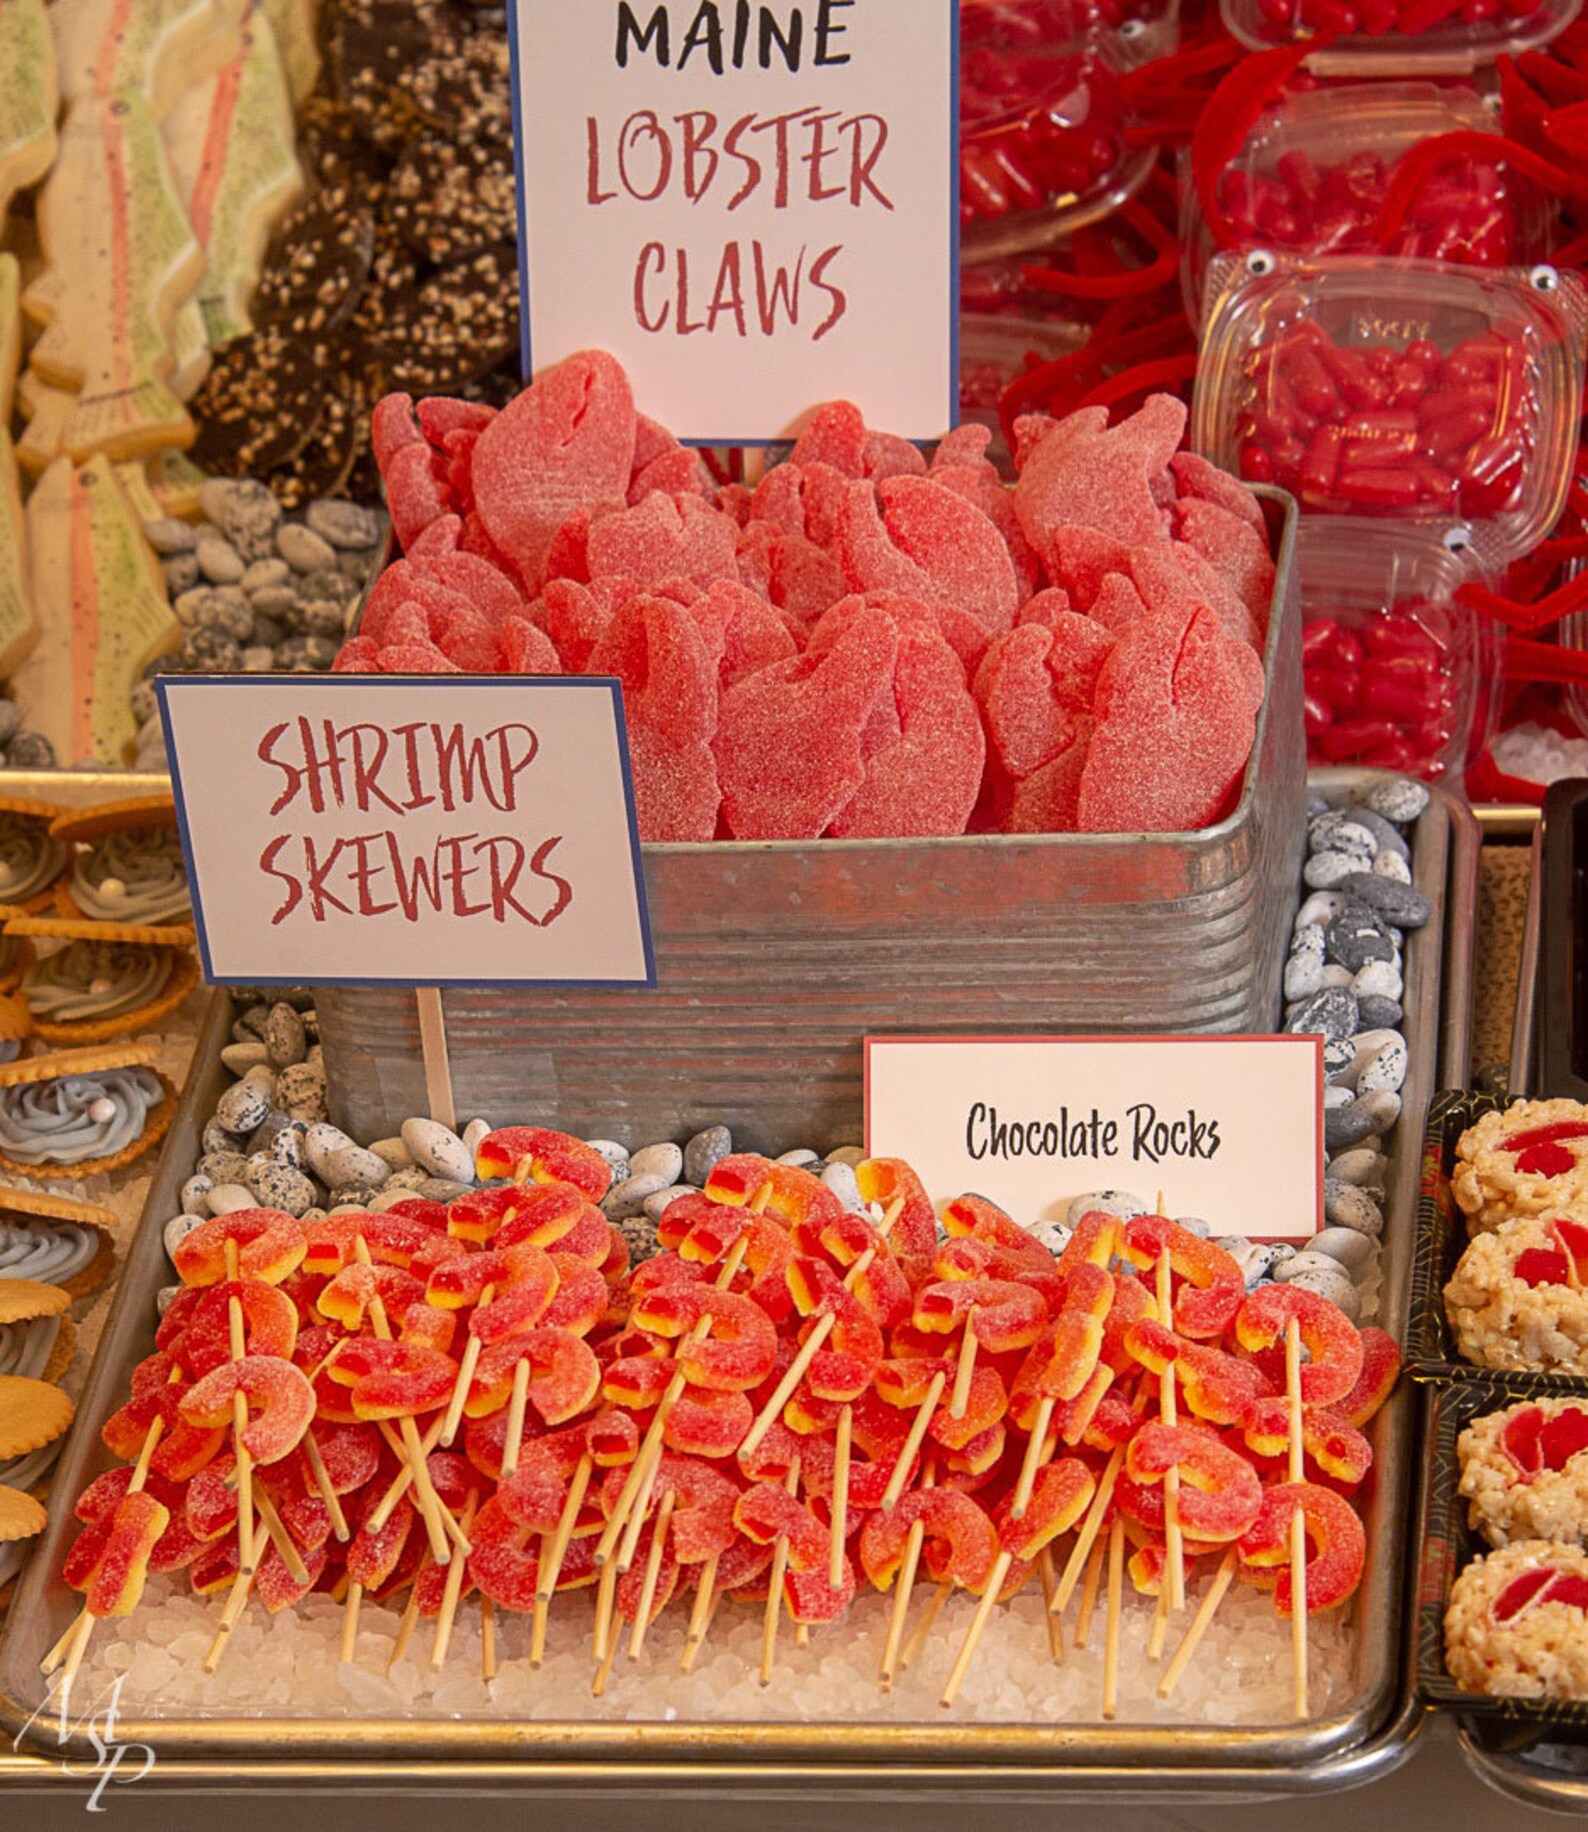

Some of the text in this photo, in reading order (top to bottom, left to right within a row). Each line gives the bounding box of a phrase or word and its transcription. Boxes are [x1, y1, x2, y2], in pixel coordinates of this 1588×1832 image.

[615, 0, 856, 75] MAINE
[587, 106, 894, 211] LOBSTER
[634, 240, 846, 341] CLAWS
[257, 716, 539, 816] SHRIMP
[260, 831, 573, 927] SKEWERS
[966, 1102, 1221, 1164] Chocolate Rocks
